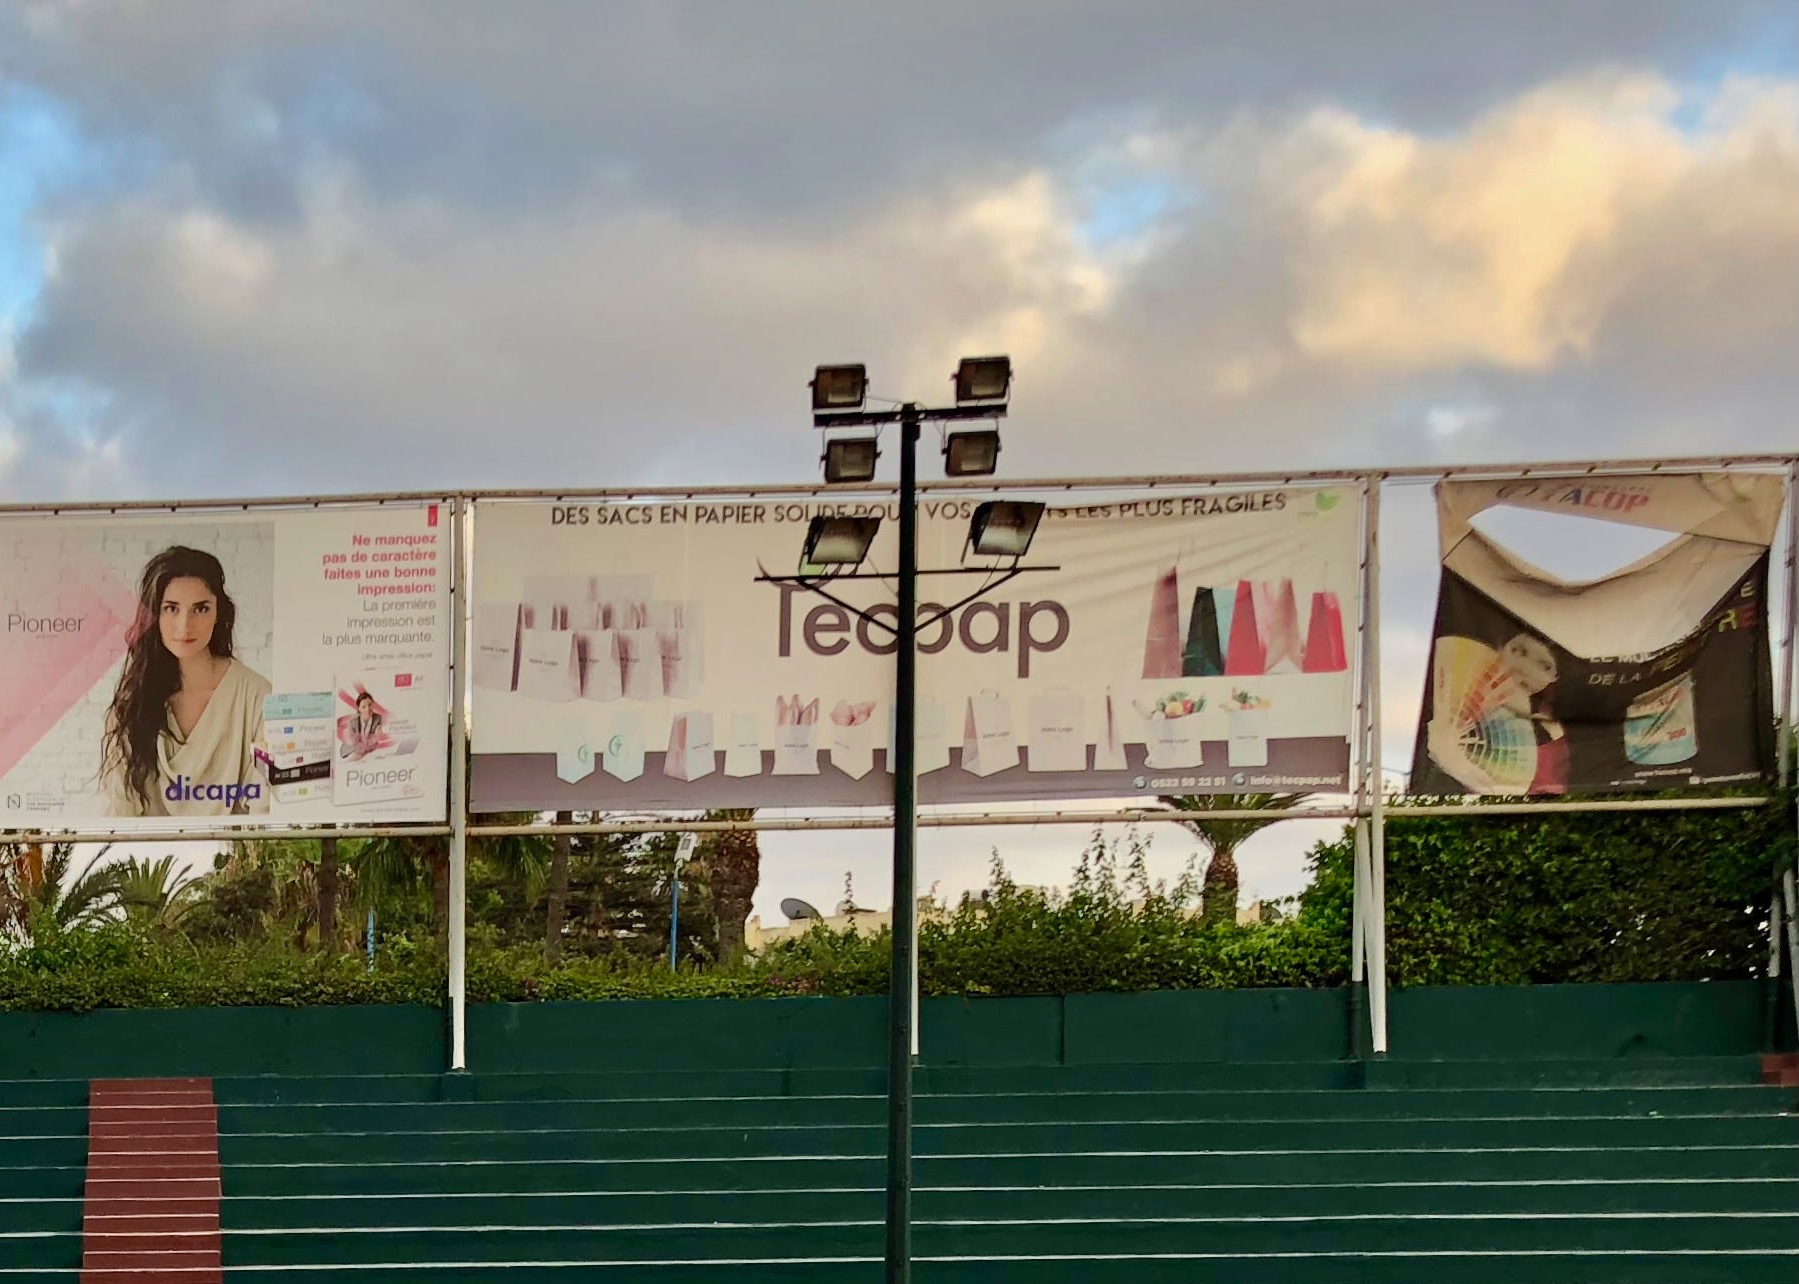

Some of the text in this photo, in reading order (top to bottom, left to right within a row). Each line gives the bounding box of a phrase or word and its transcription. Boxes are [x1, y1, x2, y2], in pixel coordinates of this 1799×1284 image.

[552, 507, 589, 525] DES
[596, 506, 652, 525] SACS
[660, 506, 688, 524] EN
[694, 505, 766, 524] PAPIER
[926, 502, 971, 520] VOS
[1119, 500, 1174, 518] PLUS
[1180, 492, 1286, 516] FRAGILES
[352, 534, 437, 547] Ne manquez
[322, 548, 436, 566] pas de caractère
[324, 566, 436, 580] faites une bonne
[362, 599, 436, 613] La première
[8, 613, 84, 633] Pioneer
[347, 614, 435, 630] impression est
[322, 633, 332, 646] la
[336, 633, 362, 647] plus
[346, 768, 416, 788] Pioneer
[165, 774, 261, 808] dicapa
